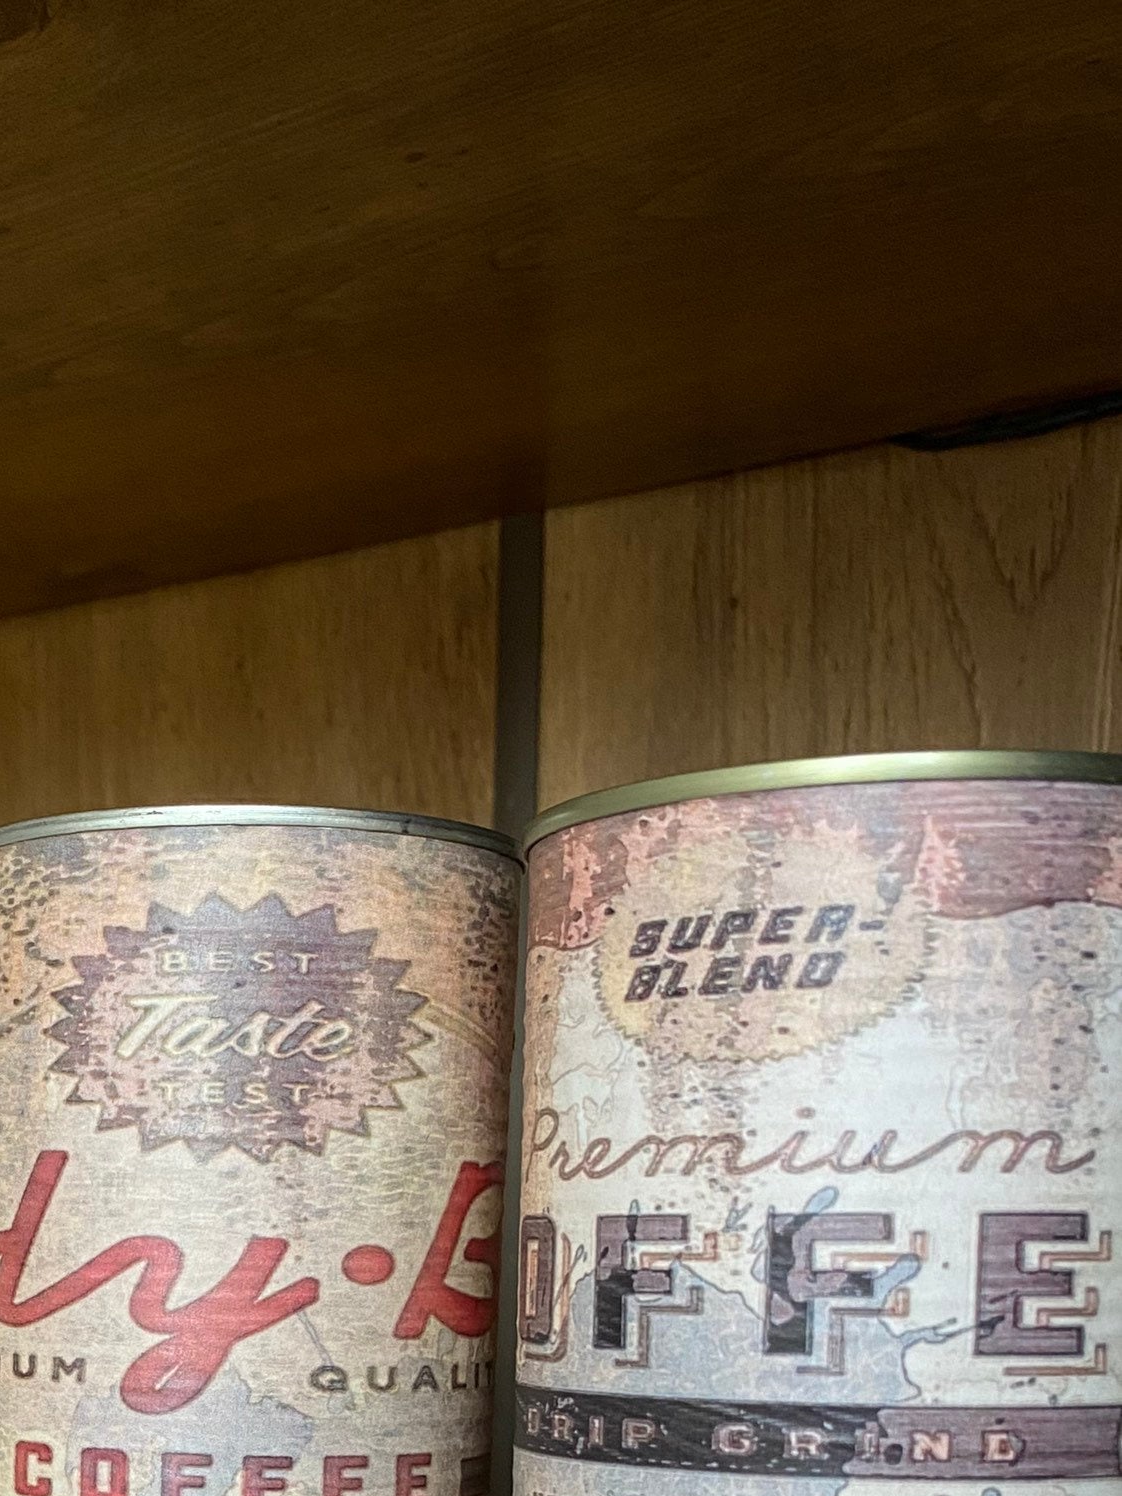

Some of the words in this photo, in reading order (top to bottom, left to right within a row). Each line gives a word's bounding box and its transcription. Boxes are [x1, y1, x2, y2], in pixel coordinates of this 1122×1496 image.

[629, 904, 884, 958] SUPER-
[159, 951, 320, 974] BEST
[625, 951, 850, 1003] BLEND
[113, 994, 354, 1062] Taste
[159, 1081, 311, 1105] TEST
[525, 1107, 1096, 1183] Premium
[517, 1210, 1100, 1366] OFFE
[712, 1420, 1025, 1465] GRIND
